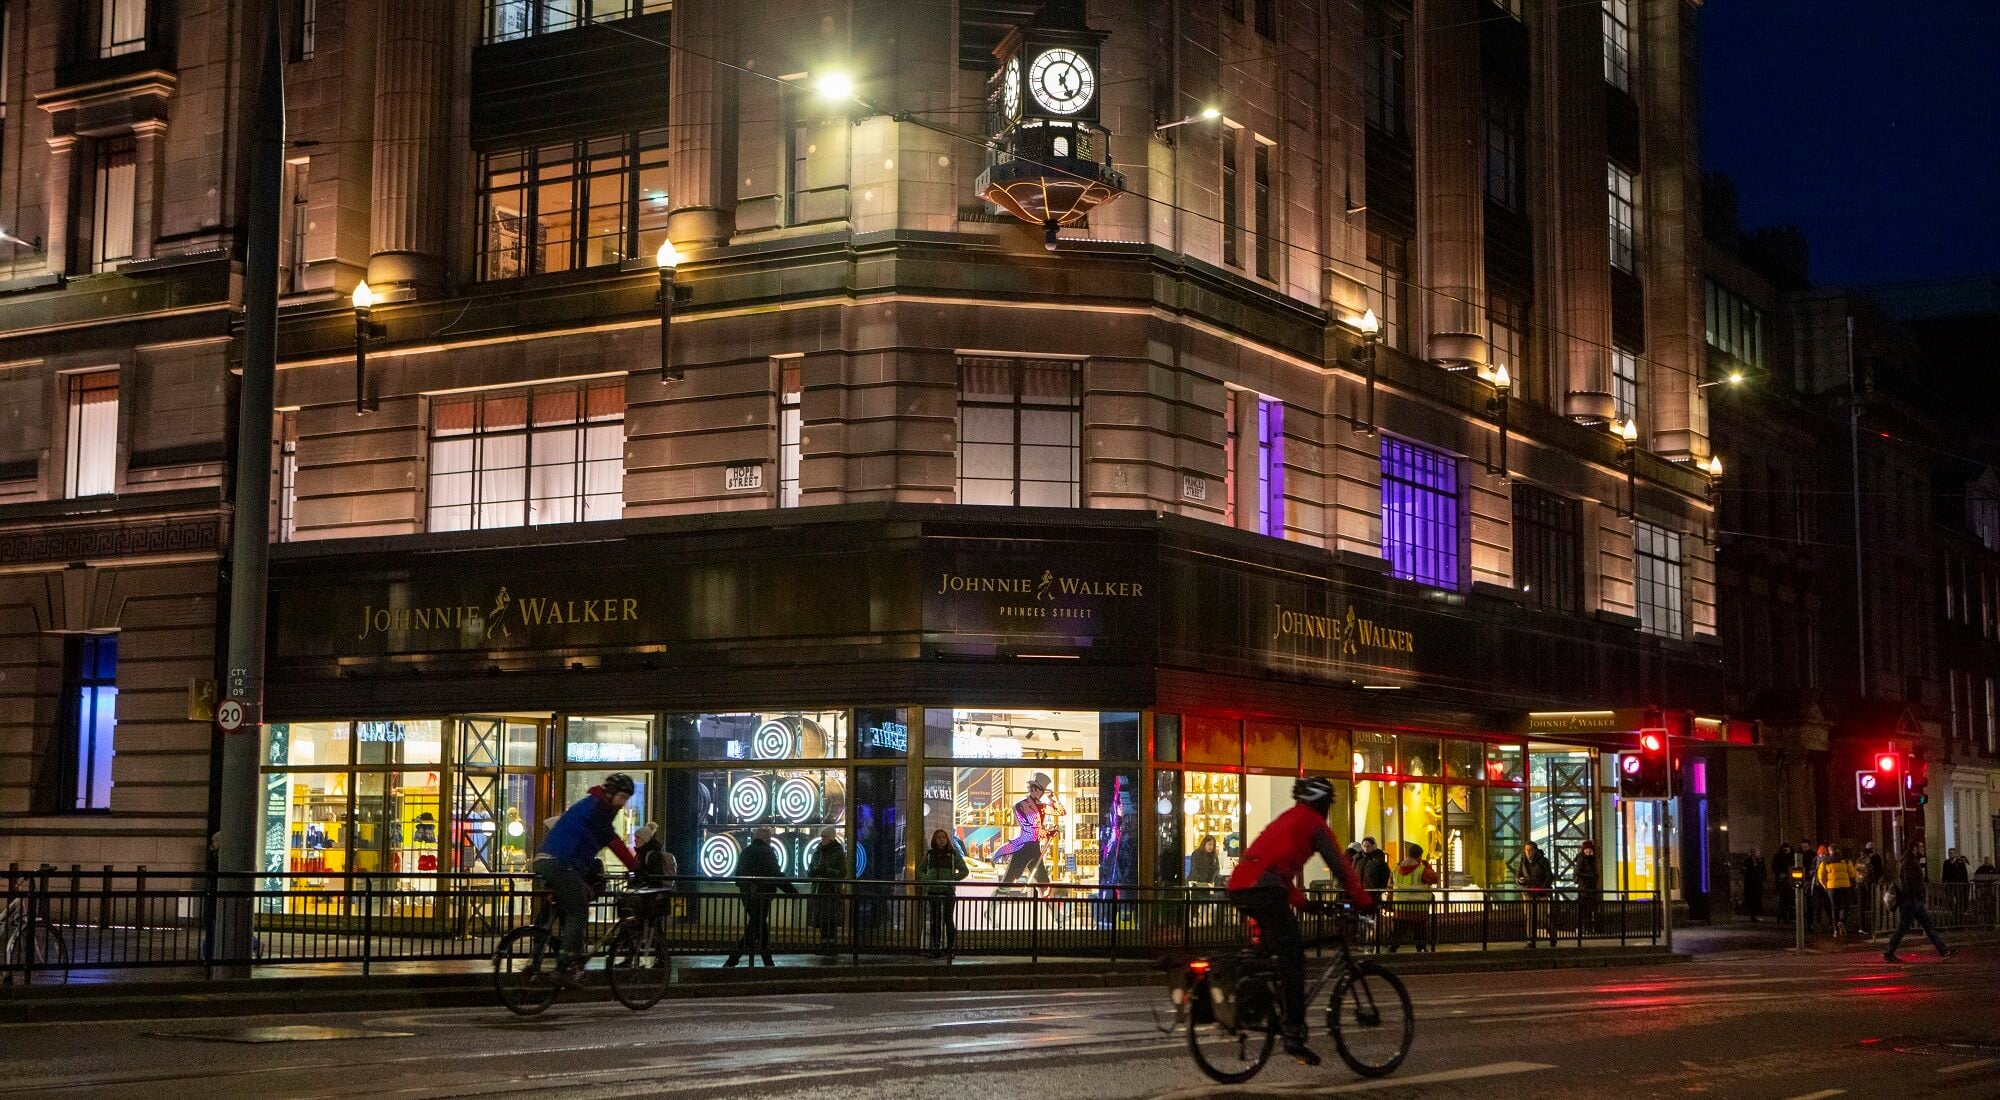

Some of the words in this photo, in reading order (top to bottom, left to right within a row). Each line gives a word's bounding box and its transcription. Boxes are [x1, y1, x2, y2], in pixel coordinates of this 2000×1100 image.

[733, 467, 754, 477] HOPE
[729, 476, 759, 488] STREET
[938, 573, 1032, 595] JOHNNIE
[1059, 577, 1143, 597] WALKER
[1000, 606, 1046, 617] PRINCES
[1052, 608, 1092, 618] STREET
[358, 605, 480, 640] JOHNNIE
[518, 597, 639, 626] WALKER
[1272, 604, 1341, 640] JOHNNIE
[1358, 618, 1414, 653] WALKER
[231, 668, 247, 676] CTY
[234, 678, 243, 686] 12
[232, 688, 244, 696] 09
[220, 708, 241, 723] 20
[1528, 719, 1568, 730] JOHNNIE
[1578, 719, 1615, 727] WALKER
